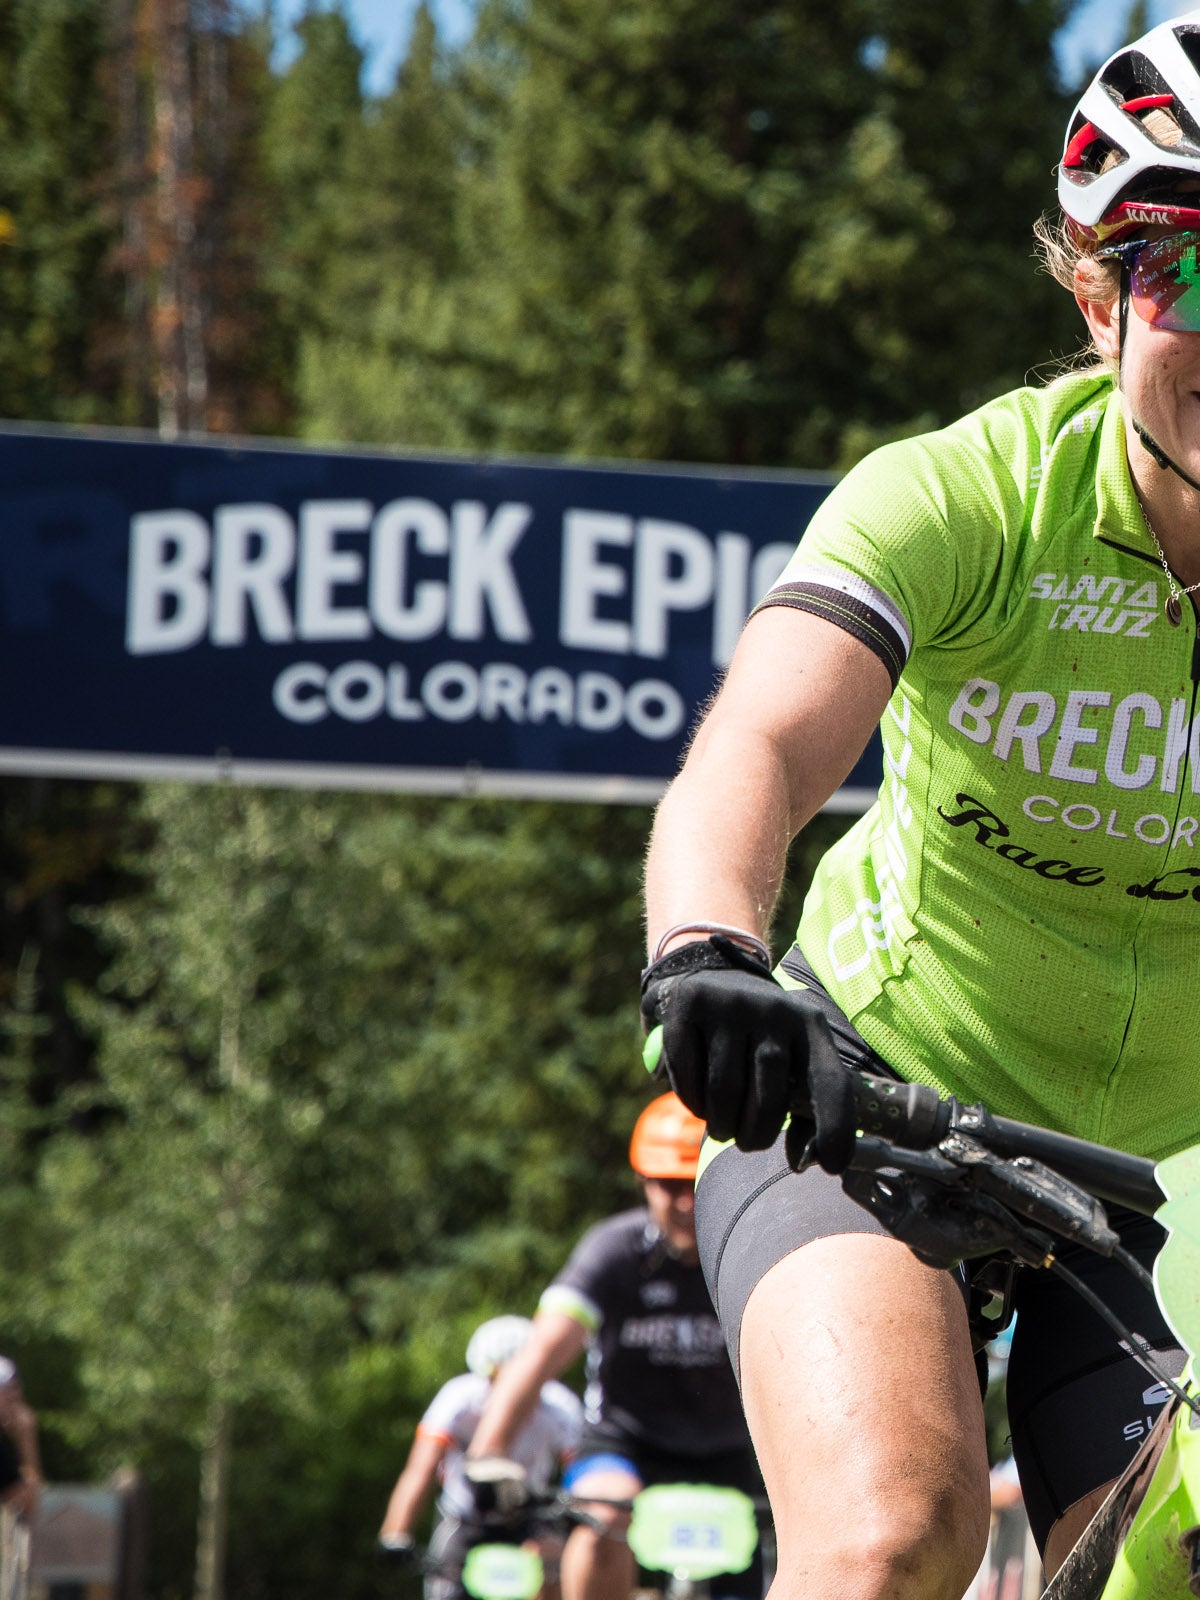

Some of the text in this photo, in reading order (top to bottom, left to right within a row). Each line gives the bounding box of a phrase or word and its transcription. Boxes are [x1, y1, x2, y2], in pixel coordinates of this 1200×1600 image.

[126, 498, 533, 655] BRECK
[1029, 573, 1157, 608] SANTA
[1048, 604, 1160, 638] CRUZ
[273, 661, 685, 740] COLORADO
[937, 792, 1105, 887] Race
